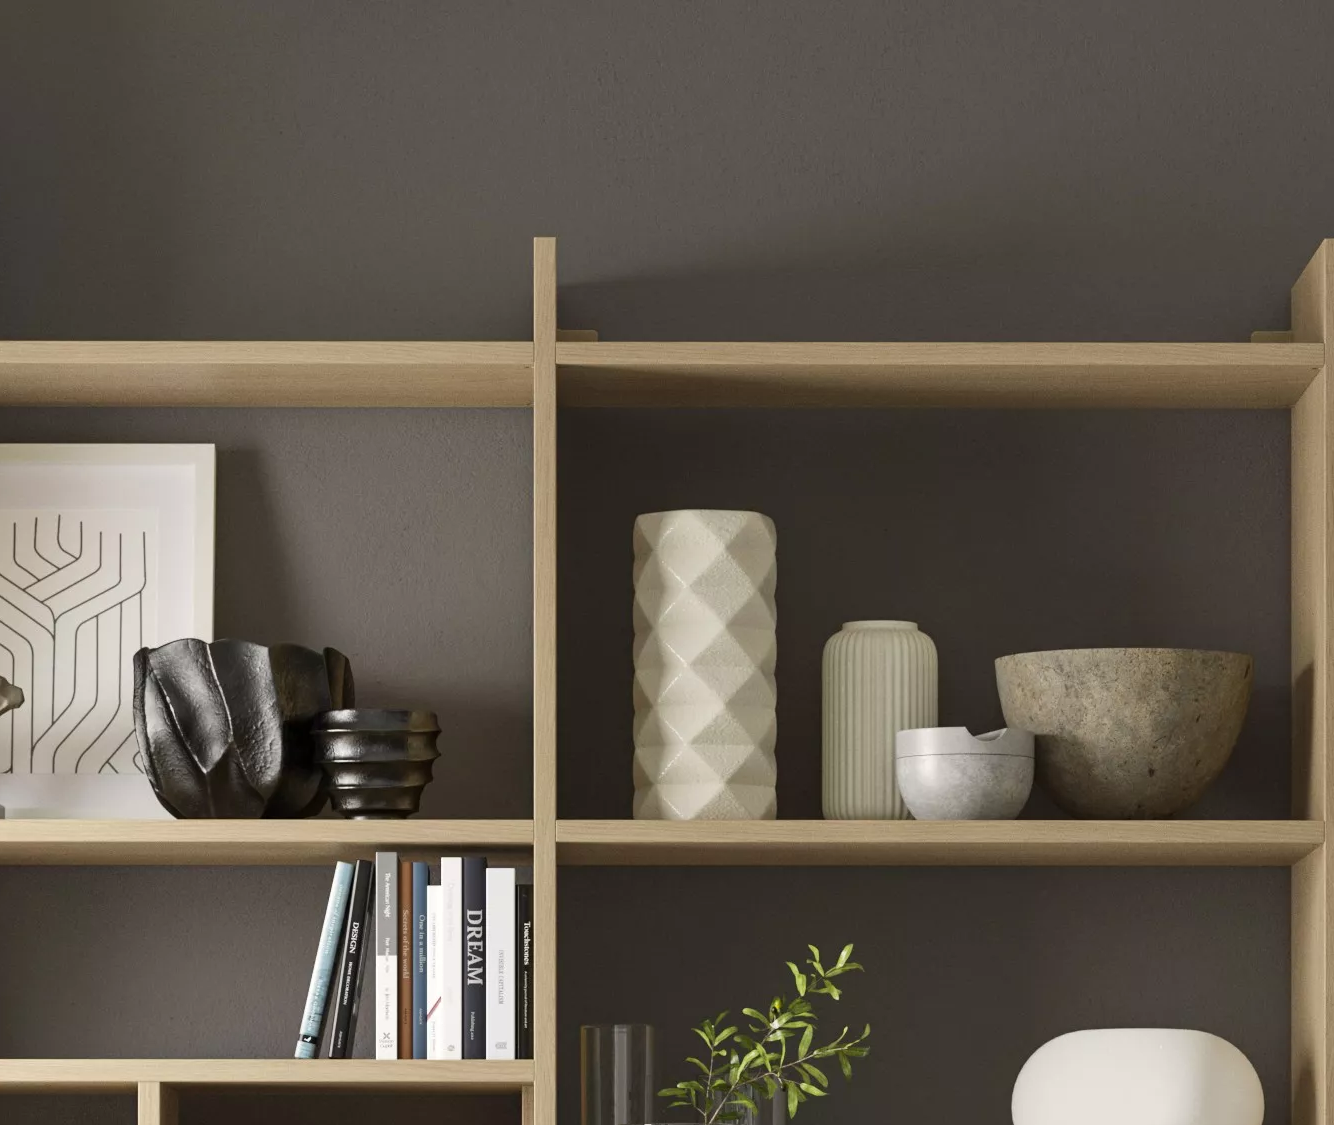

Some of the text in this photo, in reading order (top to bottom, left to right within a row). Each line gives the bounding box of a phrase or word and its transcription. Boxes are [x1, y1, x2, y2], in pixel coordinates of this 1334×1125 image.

[349, 922, 360, 954] DESIGN
[403, 936, 409, 944] of
[419, 932, 426, 940] in
[466, 909, 483, 986] DREAM
